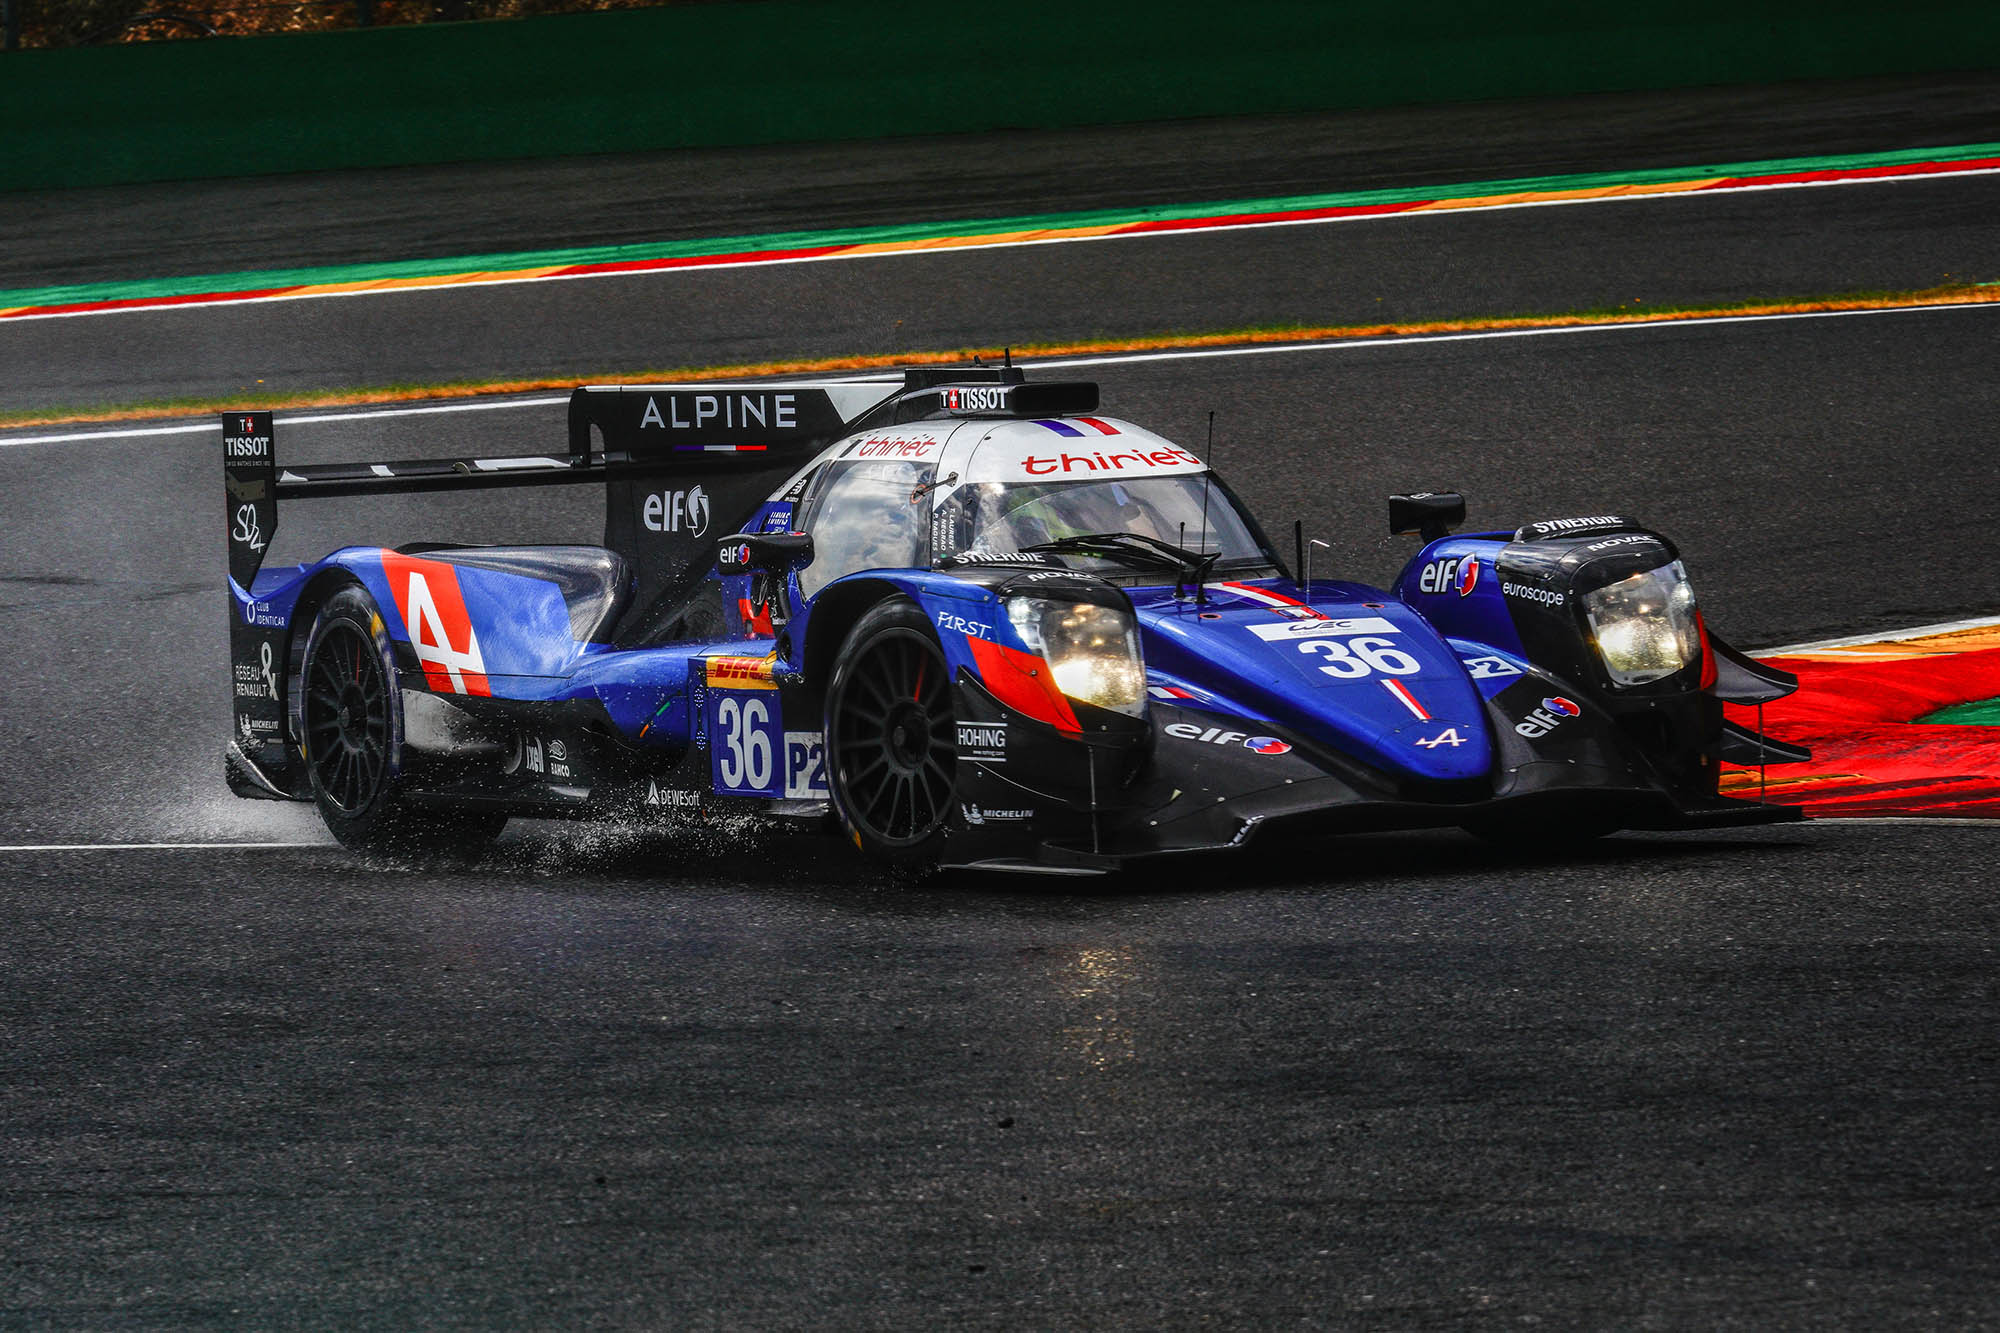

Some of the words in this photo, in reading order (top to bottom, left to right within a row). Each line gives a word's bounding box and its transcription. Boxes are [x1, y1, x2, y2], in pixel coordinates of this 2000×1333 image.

[958, 387, 1008, 409] TISSOT
[639, 394, 796, 429] ALPINE
[225, 437, 269, 456] TISSOT
[859, 436, 936, 457] thiriet
[1021, 446, 1199, 475] thiriet
[643, 490, 684, 532] elf
[1532, 515, 1623, 533] SYNERGIE
[720, 547, 737, 563] elf
[953, 552, 1044, 564] SYNERGIE
[1419, 560, 1457, 593] elf
[1502, 583, 1564, 607] euroscope
[257, 602, 269, 612] CLUB
[257, 616, 285, 626] IDENTICAR
[715, 658, 763, 680] DHL
[1297, 637, 1421, 679] 36
[236, 684, 268, 697] RENAULT
[1164, 722, 1247, 744] elf
[1515, 713, 1559, 738] elf
[719, 698, 772, 789] 36
[957, 728, 1006, 747] HOHING
[788, 743, 828, 790] P2
[660, 790, 699, 807] DEWESoft
[983, 809, 1034, 819] MICHELIN
